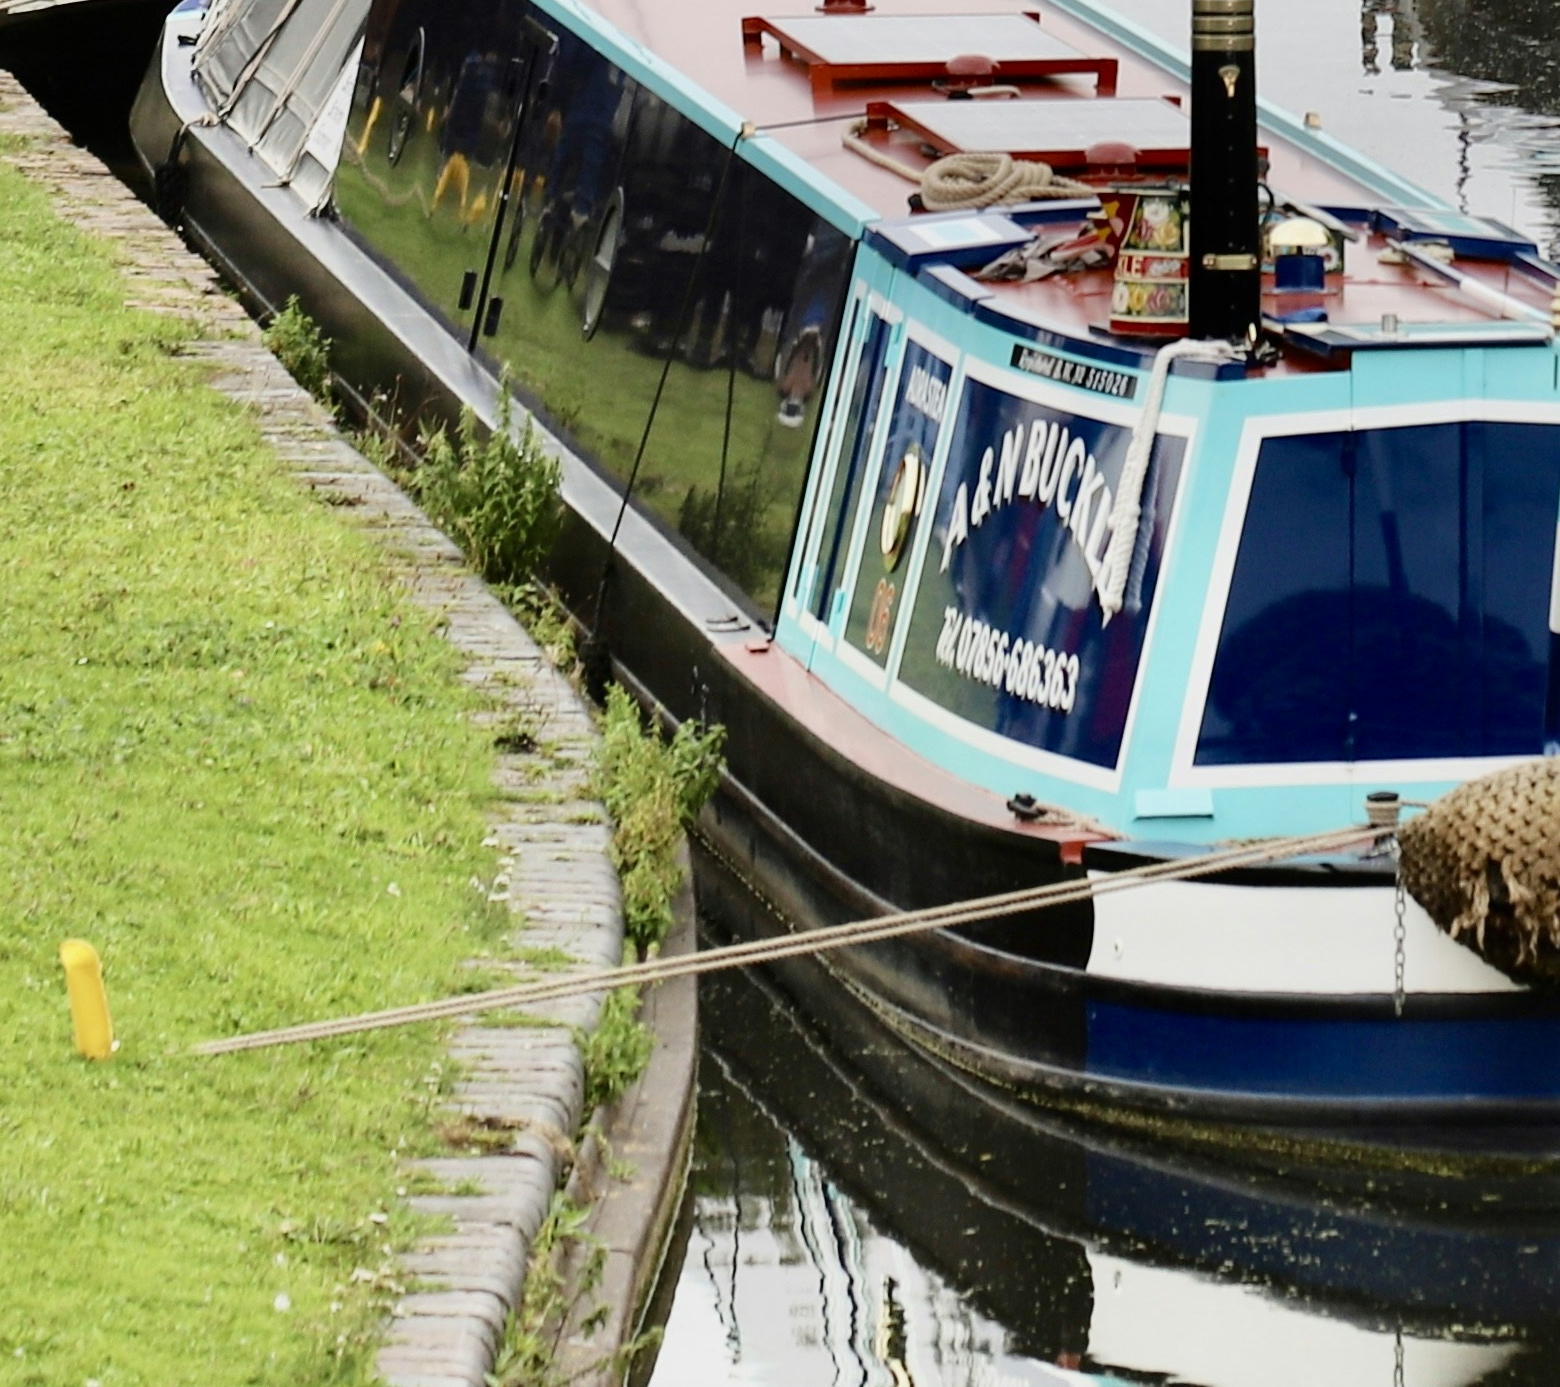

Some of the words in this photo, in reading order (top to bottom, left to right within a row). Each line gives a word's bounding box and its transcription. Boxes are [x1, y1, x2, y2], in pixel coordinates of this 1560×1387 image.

[941, 482, 968, 574] A
[970, 446, 995, 526] &
[993, 424, 1024, 510] N
